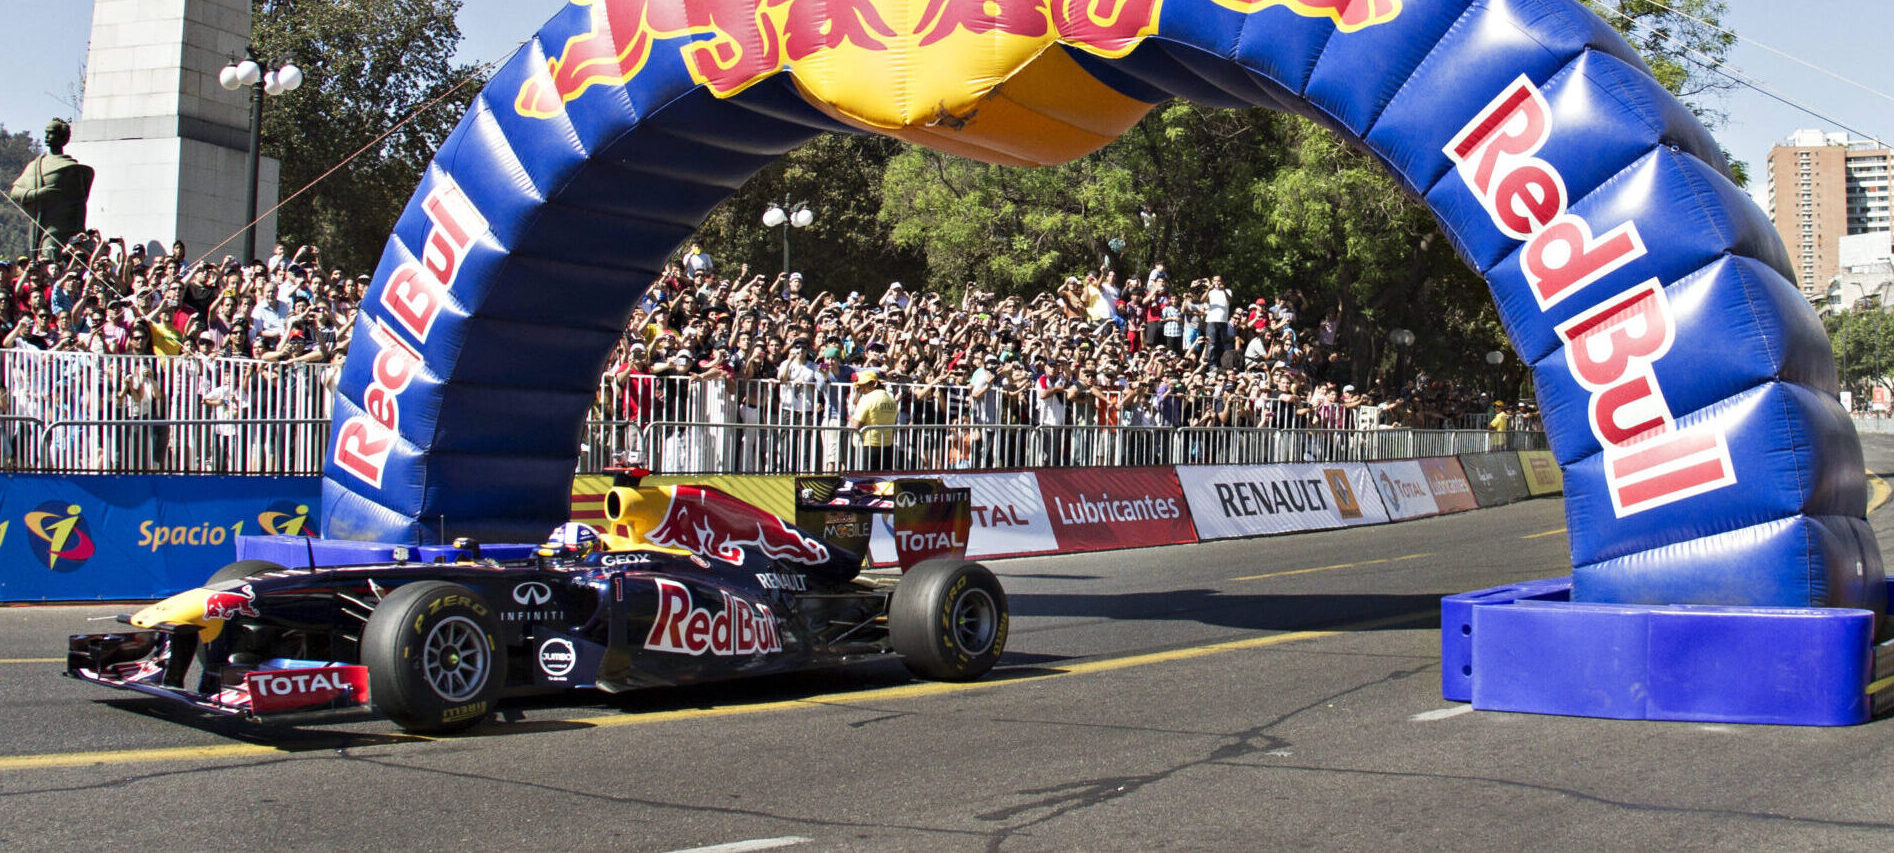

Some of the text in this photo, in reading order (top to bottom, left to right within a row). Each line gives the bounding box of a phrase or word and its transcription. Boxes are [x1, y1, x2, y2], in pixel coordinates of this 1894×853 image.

[1444, 76, 1735, 517] Red Bull
[335, 174, 488, 488] Red Bull
[916, 492, 968, 504] INFINITI
[1055, 493, 1180, 525] Lubricantes
[1214, 479, 1328, 518] RENAULT
[969, 505, 1029, 527] TAL
[138, 520, 226, 552] Spacio
[896, 530, 965, 551] TOTAL
[601, 553, 652, 567] GEOX
[614, 577, 623, 602] 1
[755, 573, 806, 592] RENAULT
[428, 594, 488, 616] ZERO
[500, 611, 564, 621] INFINITI
[251, 671, 352, 697] TOTAL
